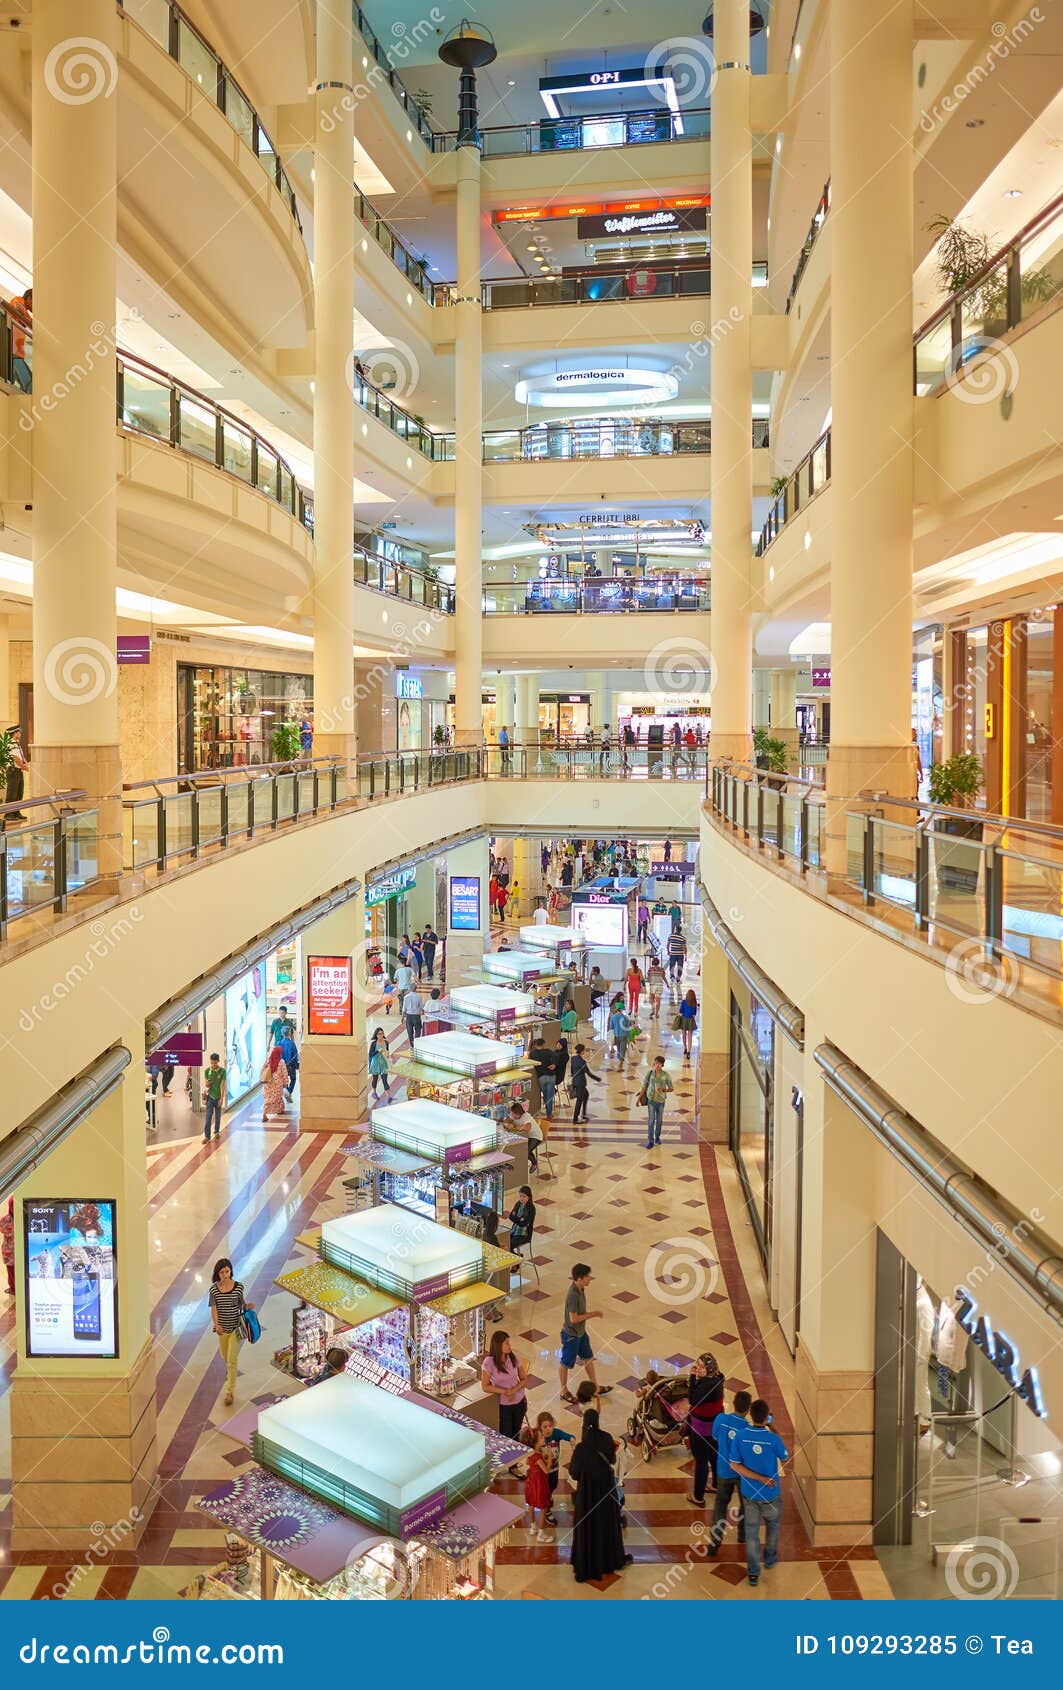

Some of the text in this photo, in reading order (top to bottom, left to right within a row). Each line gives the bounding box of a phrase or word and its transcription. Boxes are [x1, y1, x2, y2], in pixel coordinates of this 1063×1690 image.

[556, 371, 625, 382] dermalogica
[589, 894, 611, 903] Dior
[313, 967, 347, 979] I'm an
[312, 979, 348, 987] attention
[954, 1286, 1048, 1419] ZARA
